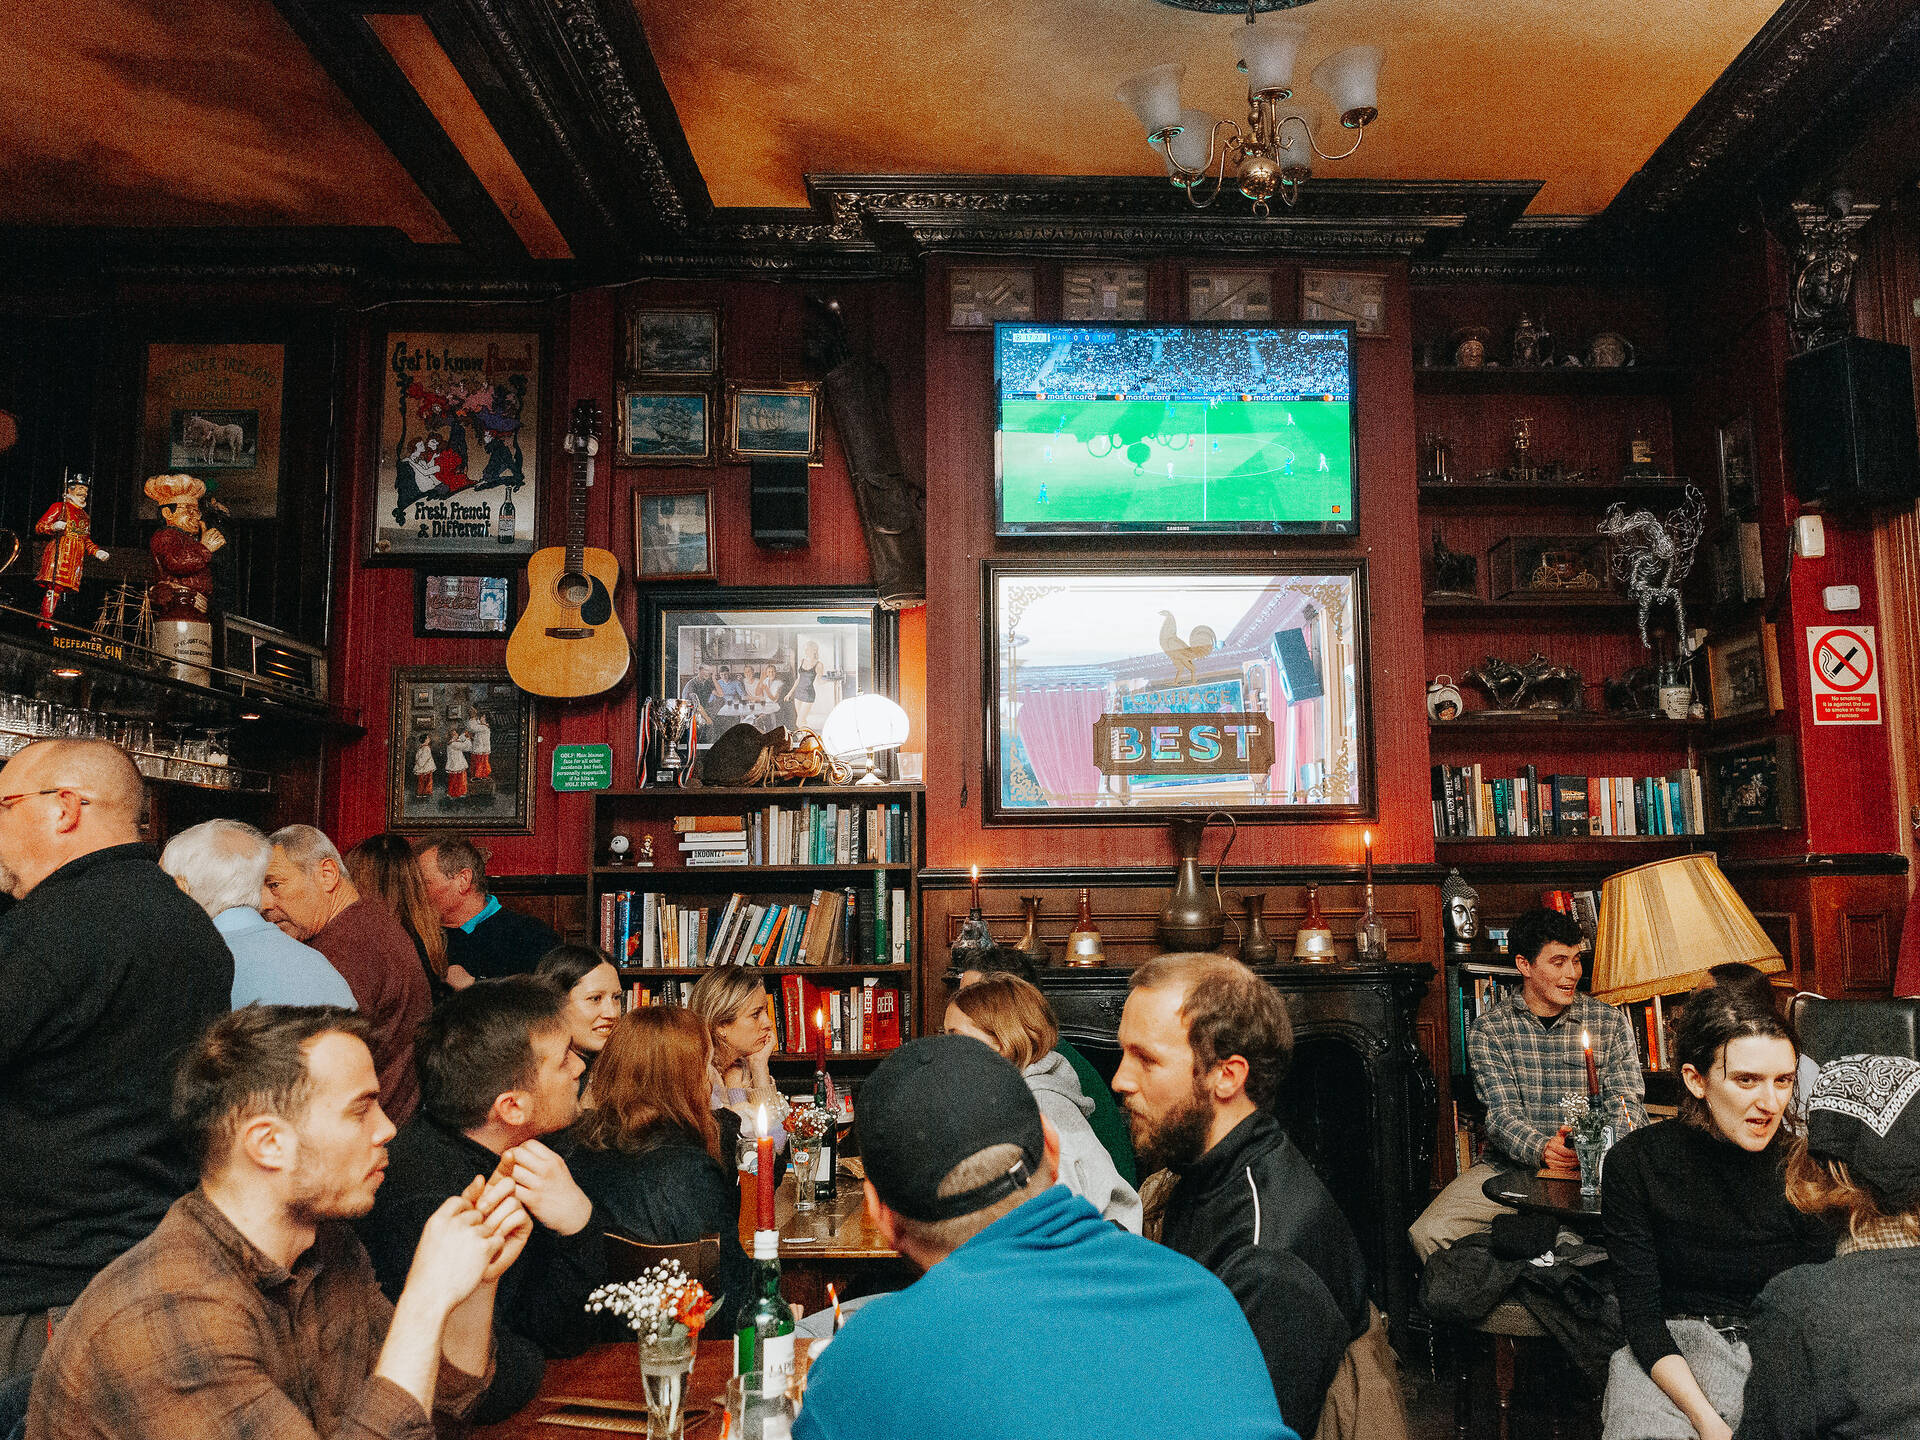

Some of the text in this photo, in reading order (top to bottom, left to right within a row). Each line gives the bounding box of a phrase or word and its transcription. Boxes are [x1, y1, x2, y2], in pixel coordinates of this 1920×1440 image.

[392, 341, 424, 372] Get
[426, 348, 441, 371] to
[443, 348, 484, 372] know
[450, 502, 491, 520] French
[418, 523, 429, 538] &
[105, 644, 122, 660] GIN
[1131, 690, 1231, 706] COURAGE
[1110, 725, 1262, 764] BEST
[1446, 780, 1454, 796] THE
[877, 996, 894, 1014] BEER
